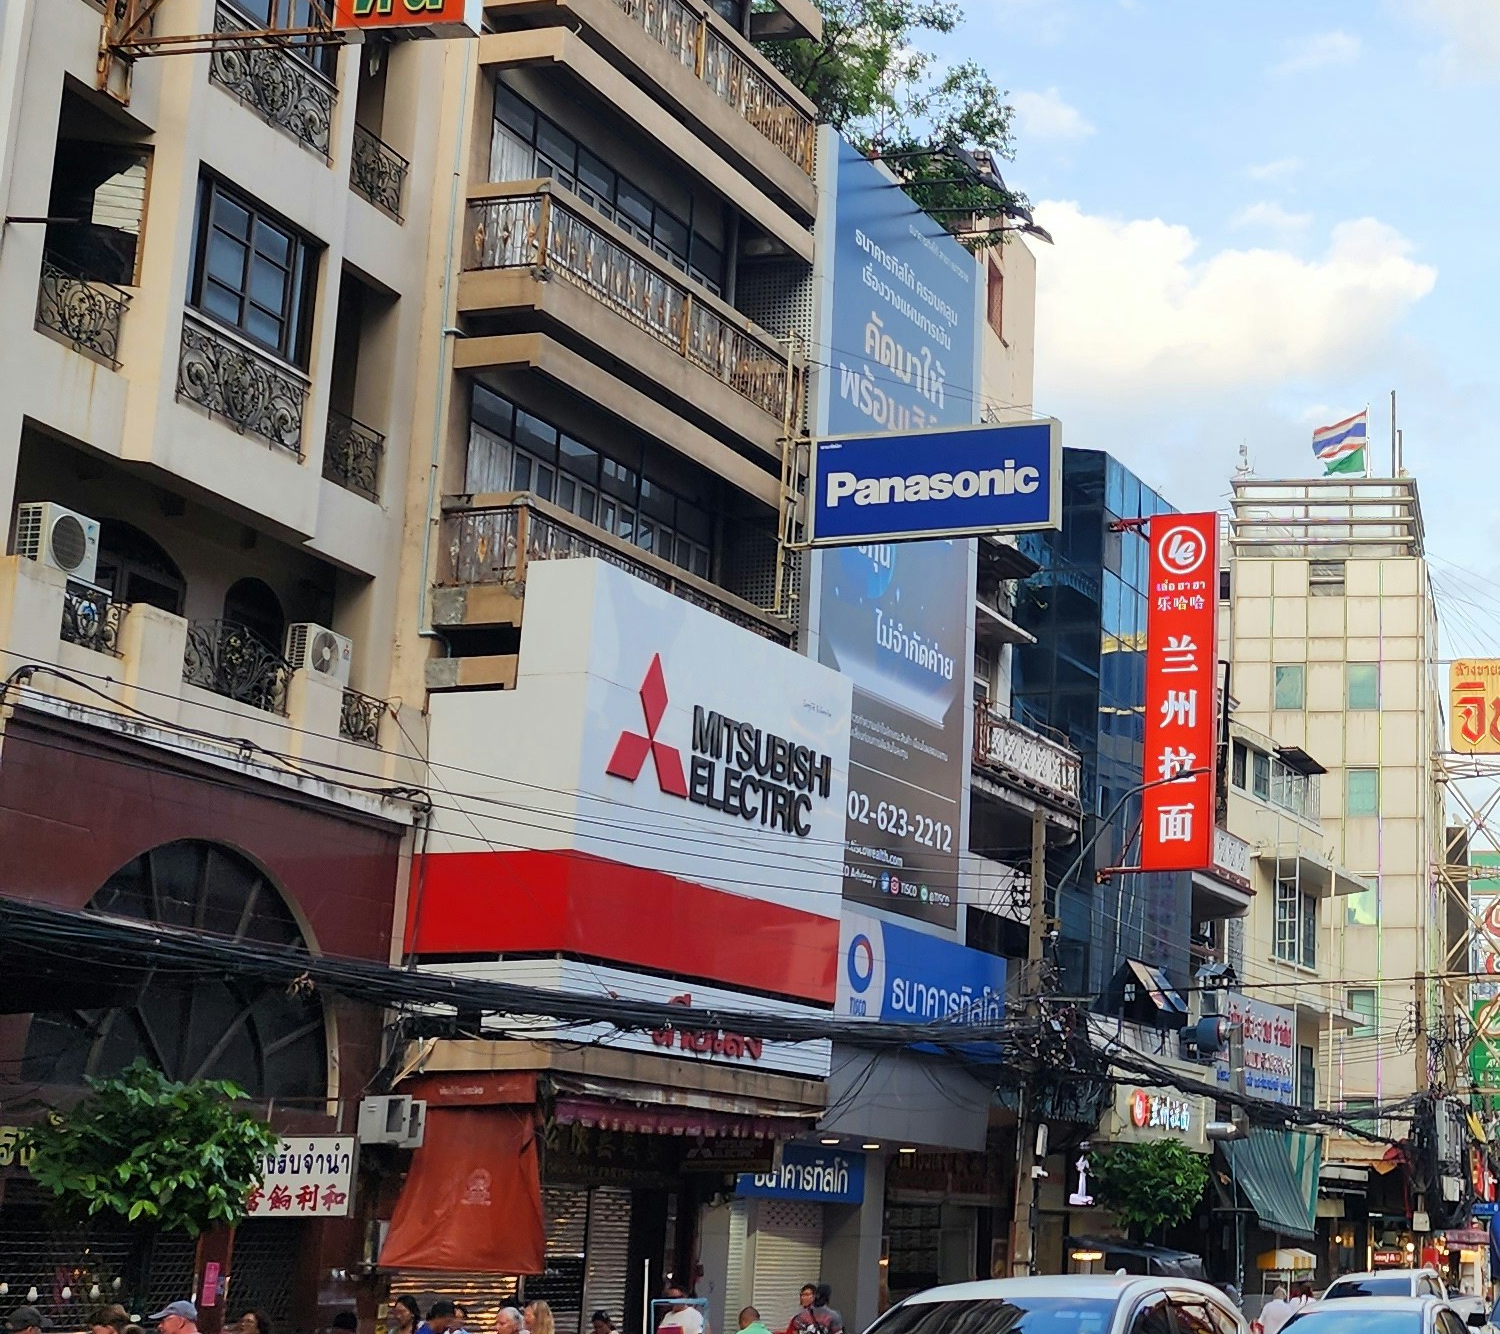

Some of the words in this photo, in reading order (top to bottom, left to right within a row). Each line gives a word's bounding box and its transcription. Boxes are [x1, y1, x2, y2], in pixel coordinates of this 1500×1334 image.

[826, 459, 1040, 508] Panasonic
[1157, 595, 1206, 611] 乐哈哈
[692, 703, 832, 799] MITSUBISHI
[1157, 634, 1199, 844] 兰州拉面
[689, 757, 812, 837] ELECTRIC
[848, 790, 952, 853] 02-623-2212
